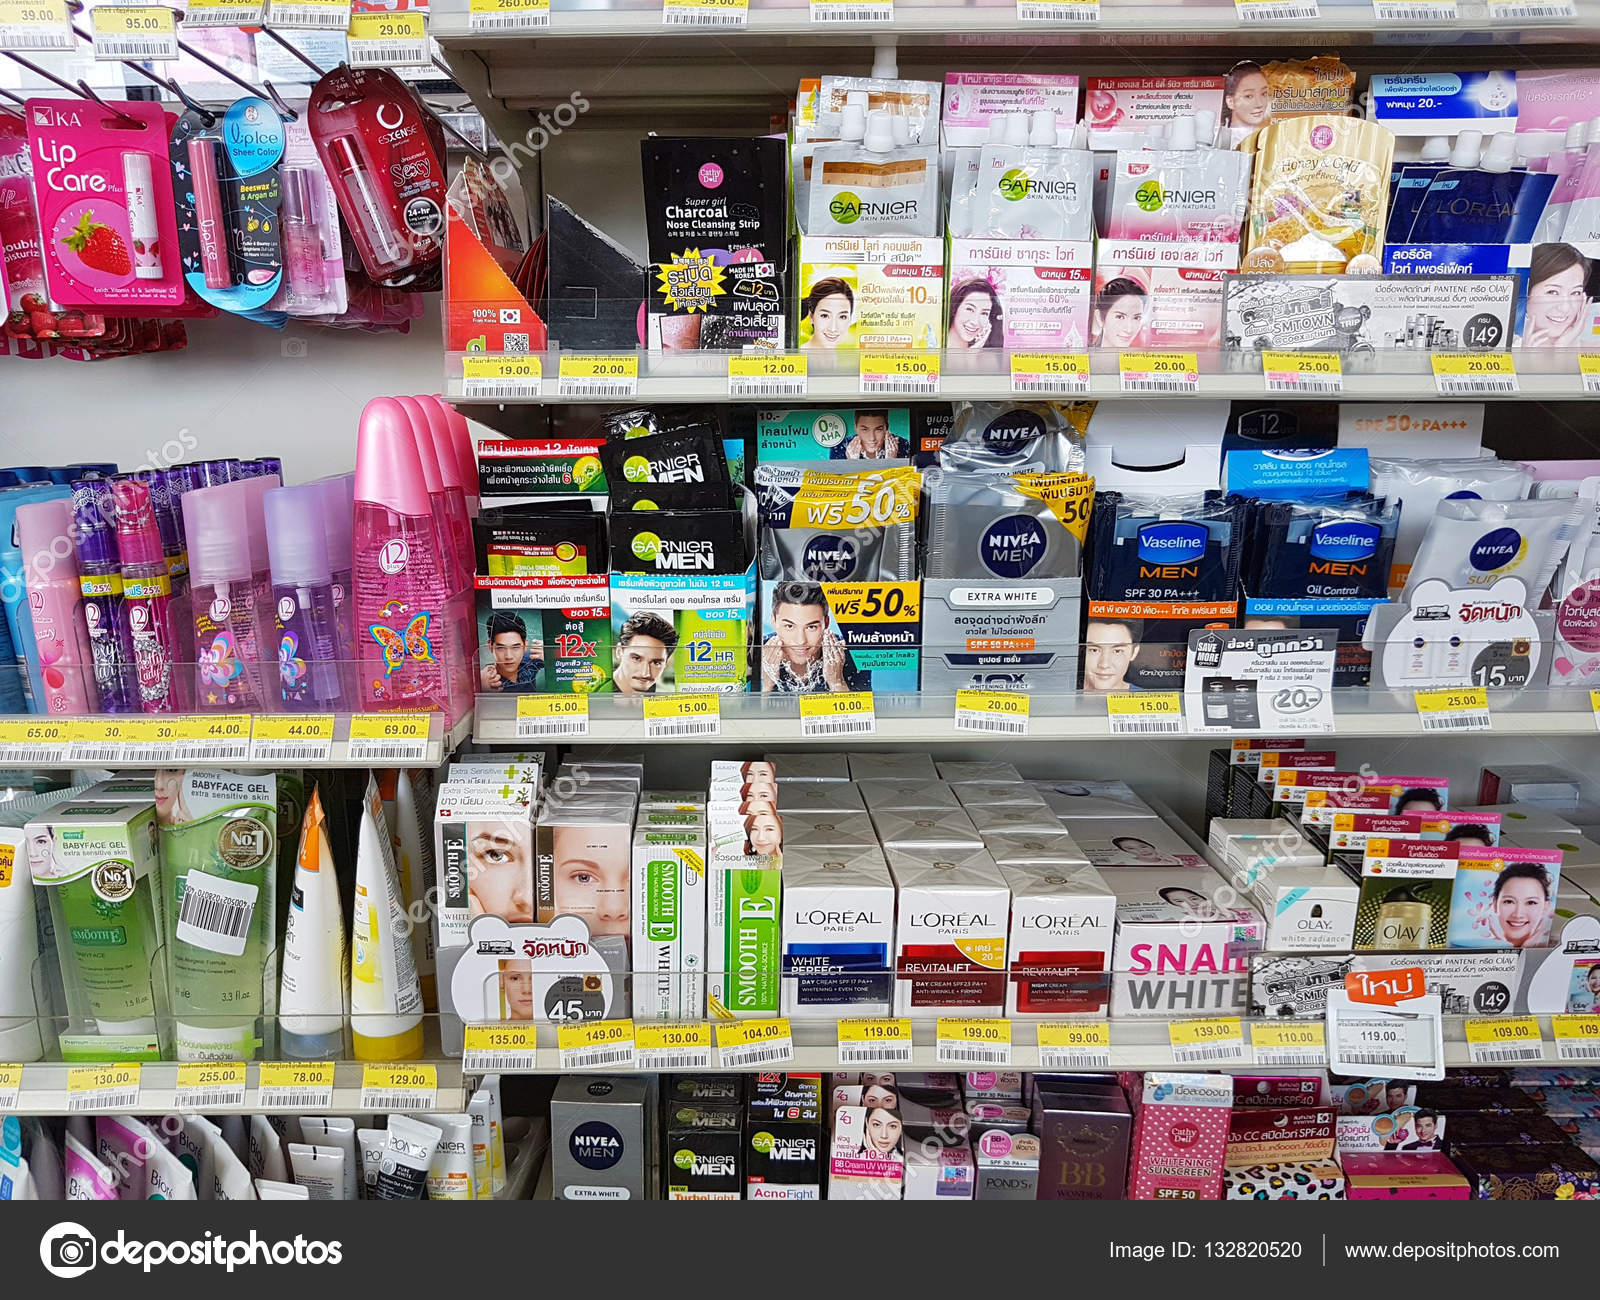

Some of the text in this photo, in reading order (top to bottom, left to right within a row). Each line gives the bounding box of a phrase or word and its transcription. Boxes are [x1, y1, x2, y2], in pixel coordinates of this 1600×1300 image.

[22, 10, 53, 21] 39.00
[126, 18, 159, 29] 95.00
[380, 25, 411, 36] 29.00
[1418, 98, 1443, 109] 20.-
[57, 112, 81, 127] KA
[38, 137, 77, 169] Lip
[233, 148, 279, 157] Sheer Color
[700, 168, 720, 178] Cathy
[47, 167, 107, 192] Care
[999, 177, 1077, 195] GARNIER
[685, 196, 727, 207] Super girl
[1135, 190, 1216, 203] GARNIER
[665, 205, 728, 219] Charcoal
[829, 200, 917, 216] GARNIER
[666, 219, 760, 231] Nose Cleansing Strip
[1055, 245, 1075, 261] ไวท์
[668, 265, 713, 285] ระเบิด
[729, 267, 746, 275] MADE
[733, 300, 780, 312] แผ่นลอก
[472, 309, 497, 318] 100%
[733, 313, 779, 328] สิวเสี้ยน
[1272, 313, 1335, 334] SMTOWN
[1468, 326, 1498, 344] 149
[499, 364, 530, 375] 19.00
[592, 363, 625, 374] 20.00
[762, 363, 795, 374] 12.00
[896, 362, 928, 372] 15.00
[1045, 362, 1077, 372] 15.00
[1154, 361, 1186, 372] 20.00
[1298, 361, 1330, 372] 25.00
[1468, 361, 1500, 372] 20.00
[820, 431, 842, 443] AHA
[989, 426, 1041, 440] NIVEA
[989, 531, 1041, 548] NIVEA
[1141, 535, 1201, 549] Vaseline
[1315, 534, 1374, 547] Vaseline
[382, 540, 409, 565] 12
[631, 540, 713, 553] GARNIER
[1476, 545, 1514, 555] NIVEA
[992, 547, 1034, 562] MEN
[655, 552, 715, 570] MEN
[1139, 566, 1199, 579] MEN
[1308, 562, 1367, 576] MEN
[1125, 588, 1200, 598] SPF 30 PA+++
[1306, 585, 1359, 595] Oil Control
[967, 592, 1038, 601] EXTRA WHITE
[1458, 602, 1522, 623] จัดหนัก
[848, 630, 915, 644] โฟมล้างหน้า
[685, 640, 734, 663] 12 HR
[1198, 642, 1217, 652] SAVE
[1197, 651, 1220, 663] MORE
[1475, 665, 1525, 687] 15 บาท
[832, 700, 862, 711] 10.00
[987, 700, 1018, 711] 20.00
[1447, 695, 1477, 706] 25.00
[548, 702, 578, 713] 15.00
[678, 702, 708, 713] 15.00
[1139, 702, 1169, 712] 15.00
[27, 727, 59, 739] 65.00
[207, 724, 240, 736] 44.00
[288, 724, 320, 736] 44.00
[384, 724, 417, 736] 69.00
[471, 767, 502, 775] Sensitive
[192, 780, 269, 794] BABYFACE GEL
[191, 790, 270, 801] extra sensitive skin
[62, 841, 126, 850] BABYFACE GEL
[230, 830, 264, 856] No.1
[114, 849, 128, 857] skin
[104, 867, 133, 889] No.1
[445, 913, 471, 921] WHITE
[796, 910, 882, 926] L'ORÉAL
[911, 912, 996, 928] L'ORÉAL
[1022, 914, 1108, 929] L'ORÉAL
[1281, 934, 1345, 943] white radiance
[522, 939, 588, 958] จัดหนัก
[791, 956, 831, 966] WHITE
[657, 944, 671, 996] WHITE
[905, 962, 972, 973] REVITALIFT
[1355, 972, 1414, 997] ใหม่
[1479, 993, 1506, 1008] 149
[548, 999, 584, 1021] 45
[586, 1027, 623, 1042] 149.00
[742, 1025, 779, 1040] 104.00
[863, 1026, 900, 1037] 119.00
[962, 1027, 999, 1039] 199.00
[1193, 1024, 1230, 1037] 139.00
[1360, 1030, 1397, 1042] 119.00
[1492, 1026, 1529, 1038] 109.00
[489, 1034, 526, 1045] 135.00
[662, 1032, 699, 1044] 130.00
[1068, 1032, 1099, 1043] 99.00
[1277, 1031, 1313, 1043] 110.00
[93, 1072, 130, 1085] 130.00
[198, 1070, 236, 1082] 255.00
[292, 1071, 323, 1083] 78.00
[389, 1073, 426, 1085] 129.00
[691, 1118, 736, 1127] MEN
[1171, 1127, 1197, 1137] Cathy
[574, 1135, 619, 1148] NIVEA
[751, 1137, 816, 1148] GARNIER
[1174, 1134, 1192, 1143] Doll
[578, 1147, 615, 1158] MEN
[769, 1147, 816, 1161] MEN
[673, 1155, 736, 1165] GARNIER
[834, 1160, 844, 1168] BB
[845, 1160, 866, 1169] Cream
[866, 1161, 877, 1170] UV
[1149, 1157, 1212, 1168] WHITENING
[690, 1163, 735, 1176] MEN
[1148, 1166, 1212, 1177] SUNSCREEN
[574, 1190, 620, 1198] EXTRA WHITE
[754, 1187, 814, 1200] AcnoFight
[1158, 1189, 1196, 1199] SPF 50
